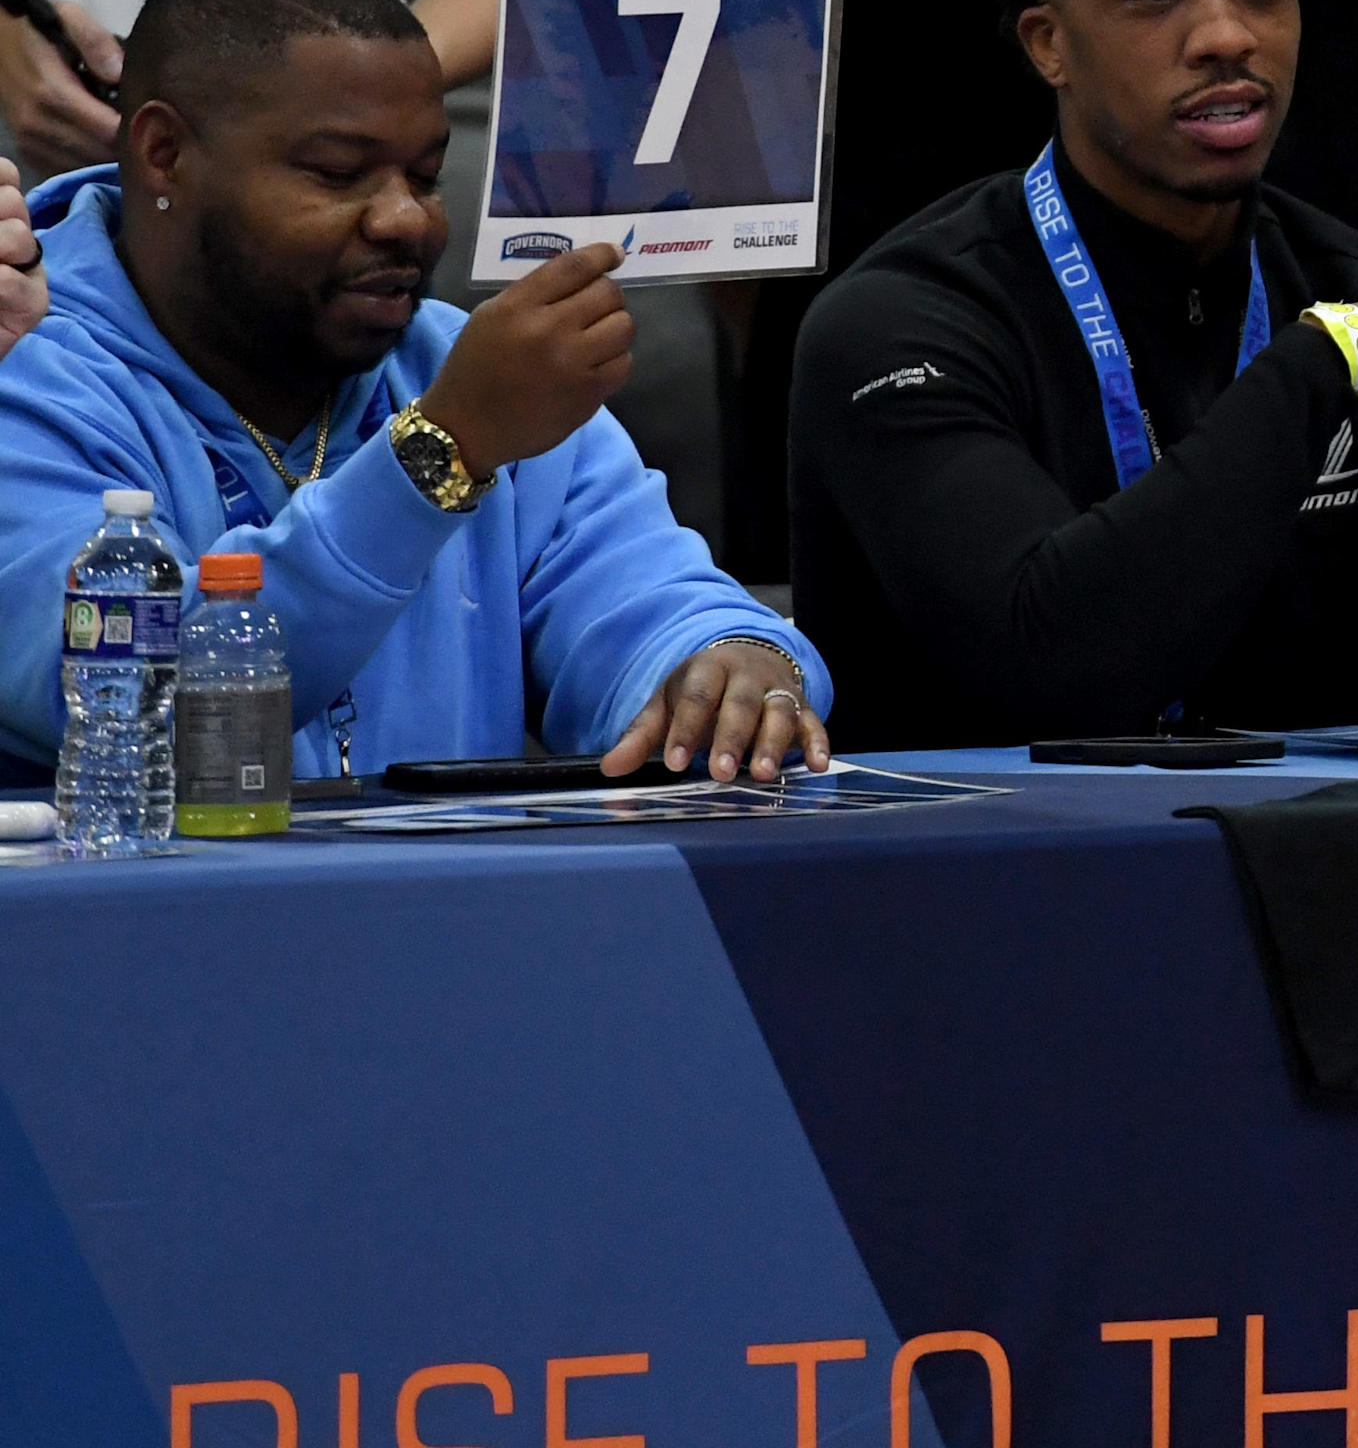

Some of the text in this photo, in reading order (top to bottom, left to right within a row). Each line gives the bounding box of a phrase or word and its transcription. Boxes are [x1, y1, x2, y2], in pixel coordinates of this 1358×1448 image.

[734, 219, 799, 234] RISE TO THE
[505, 234, 571, 255] GOVERNORS
[638, 239, 713, 255] PIEDMONT
[733, 234, 799, 249] CHALLENGE
[1029, 169, 1068, 240] RISE
[1055, 242, 1090, 287] TO
[1077, 293, 1119, 358] THE
[896, 376, 926, 388] Group
